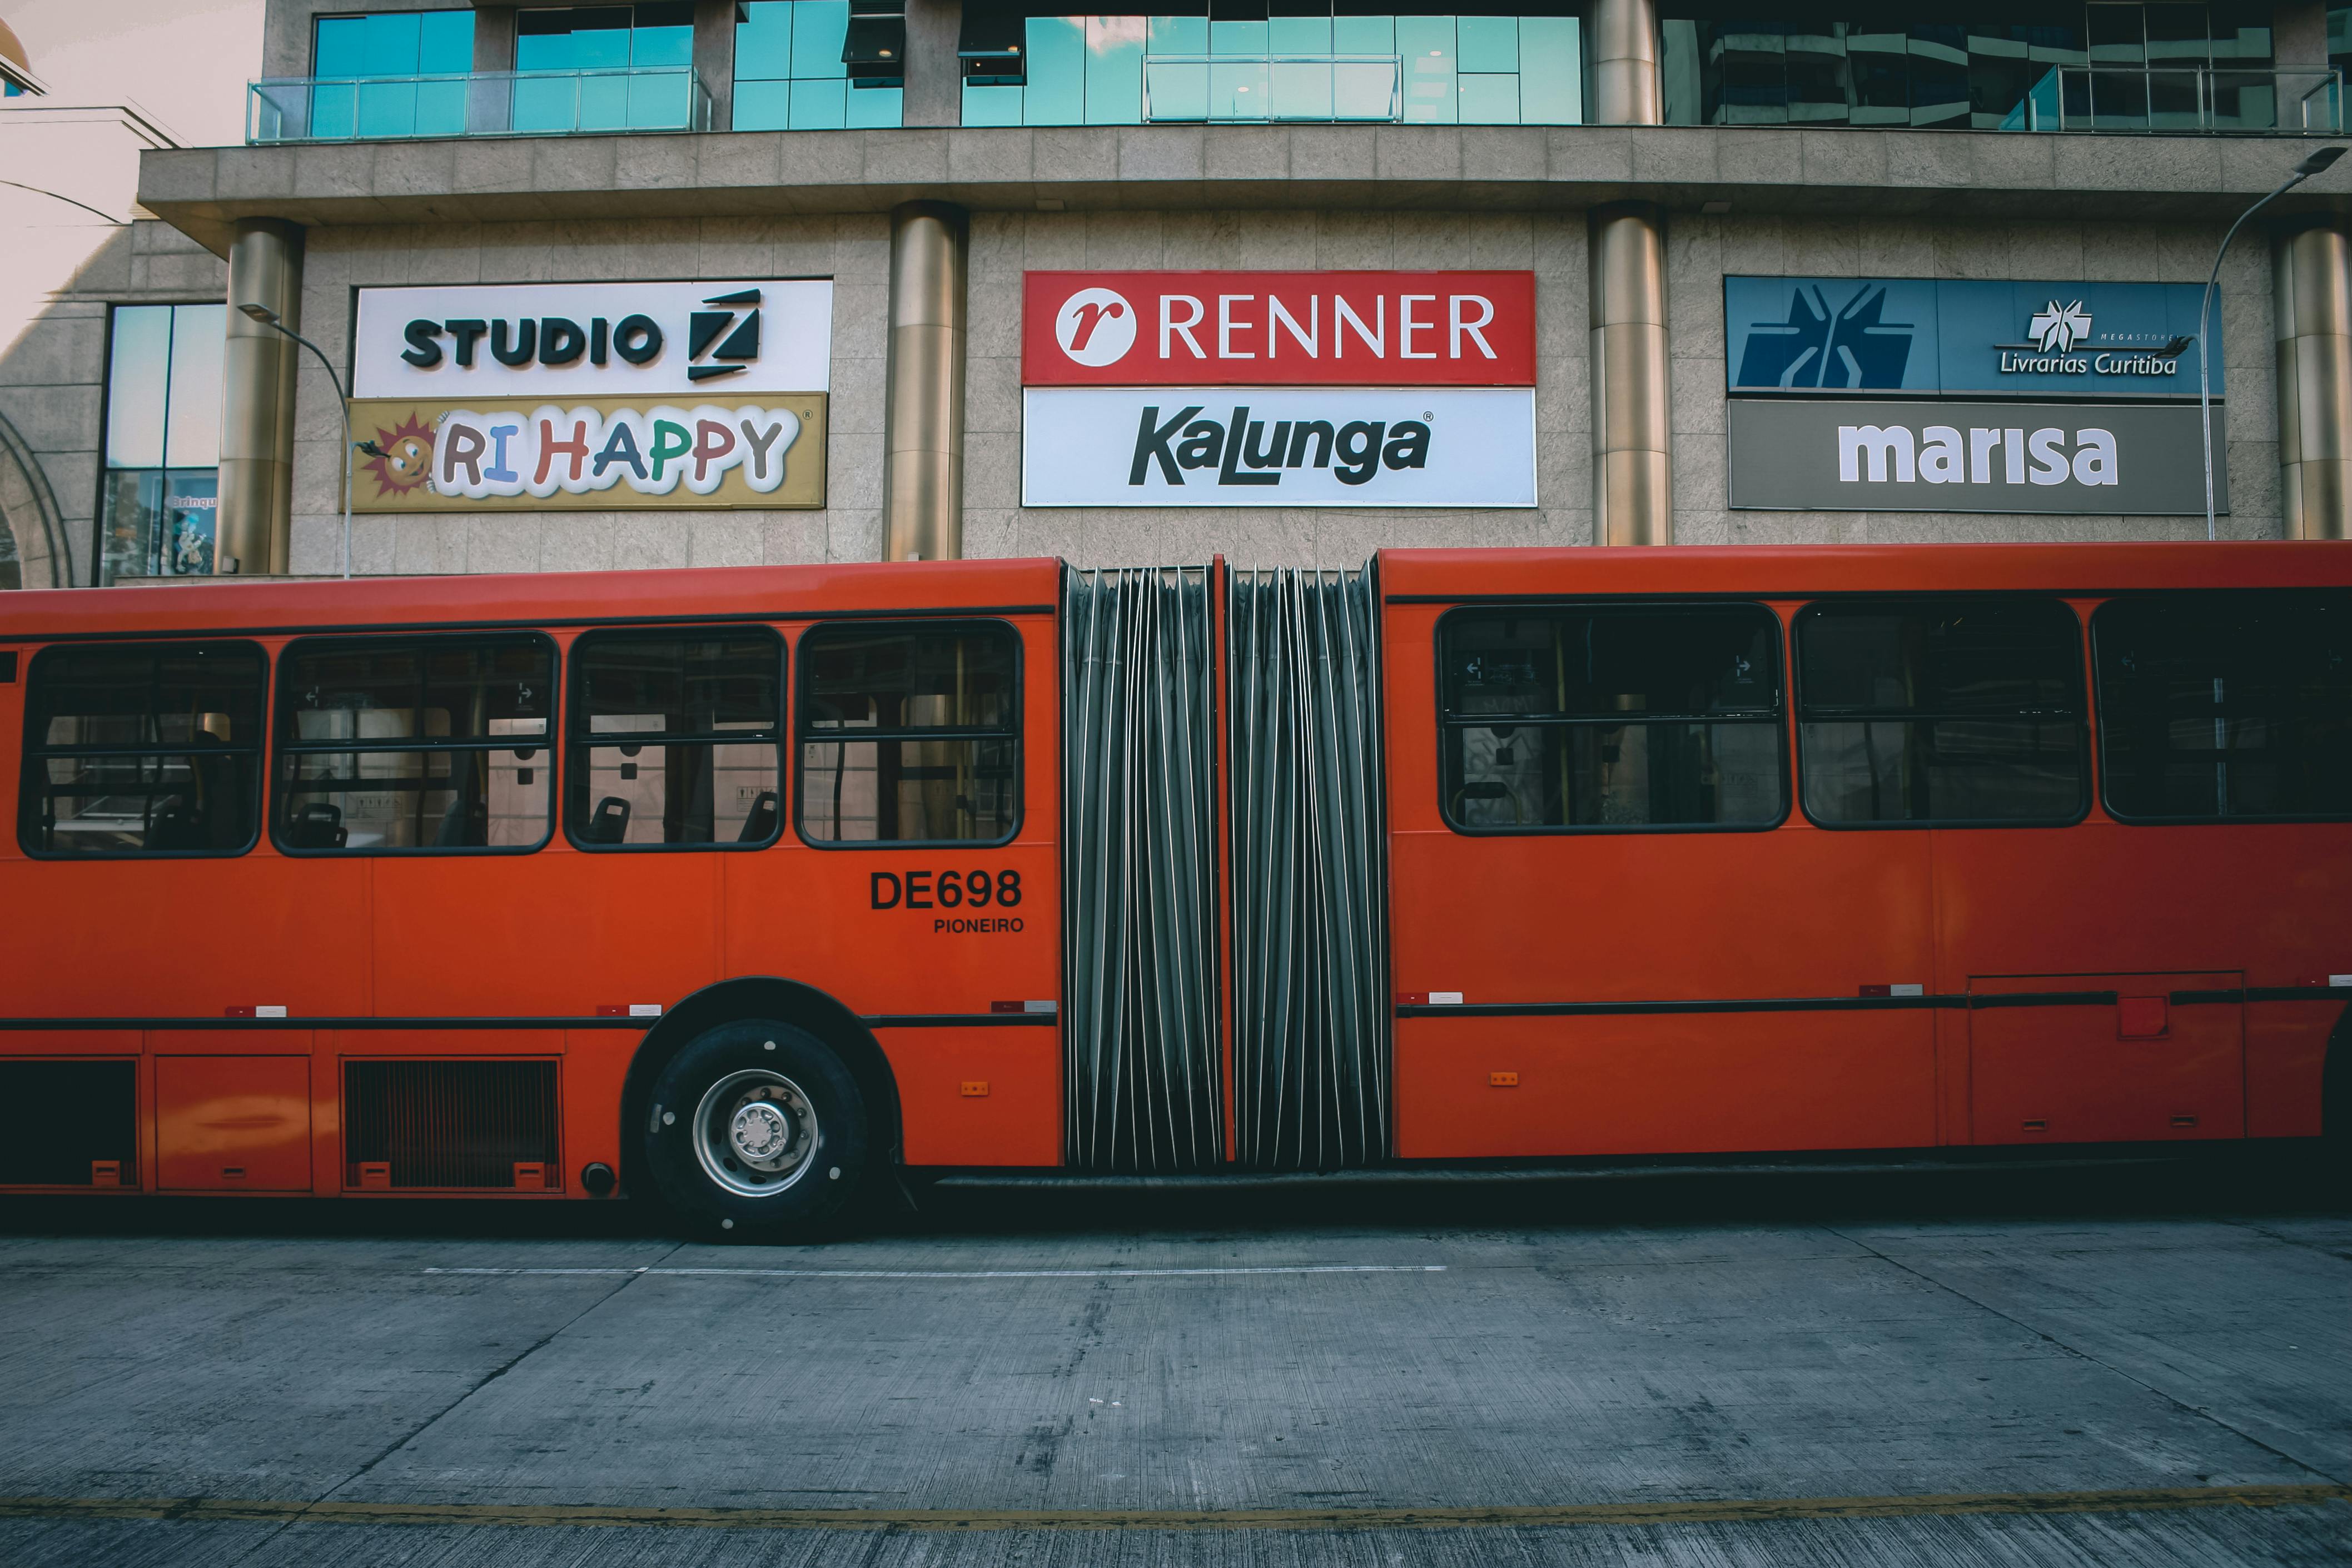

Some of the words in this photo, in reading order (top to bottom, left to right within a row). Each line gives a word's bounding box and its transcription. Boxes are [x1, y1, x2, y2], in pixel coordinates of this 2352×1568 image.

[400, 314, 663, 368] STUDIO
[1159, 295, 1498, 359] RENNER
[2001, 351, 2087, 375] Livrarias
[2095, 353, 2177, 375] Curitiba
[442, 423, 520, 486] RI
[533, 419, 783, 485] HAPPY
[1838, 425, 2119, 486] marisa
[871, 869, 1022, 910] DE698
[934, 918, 1024, 933] PIONEIRO
